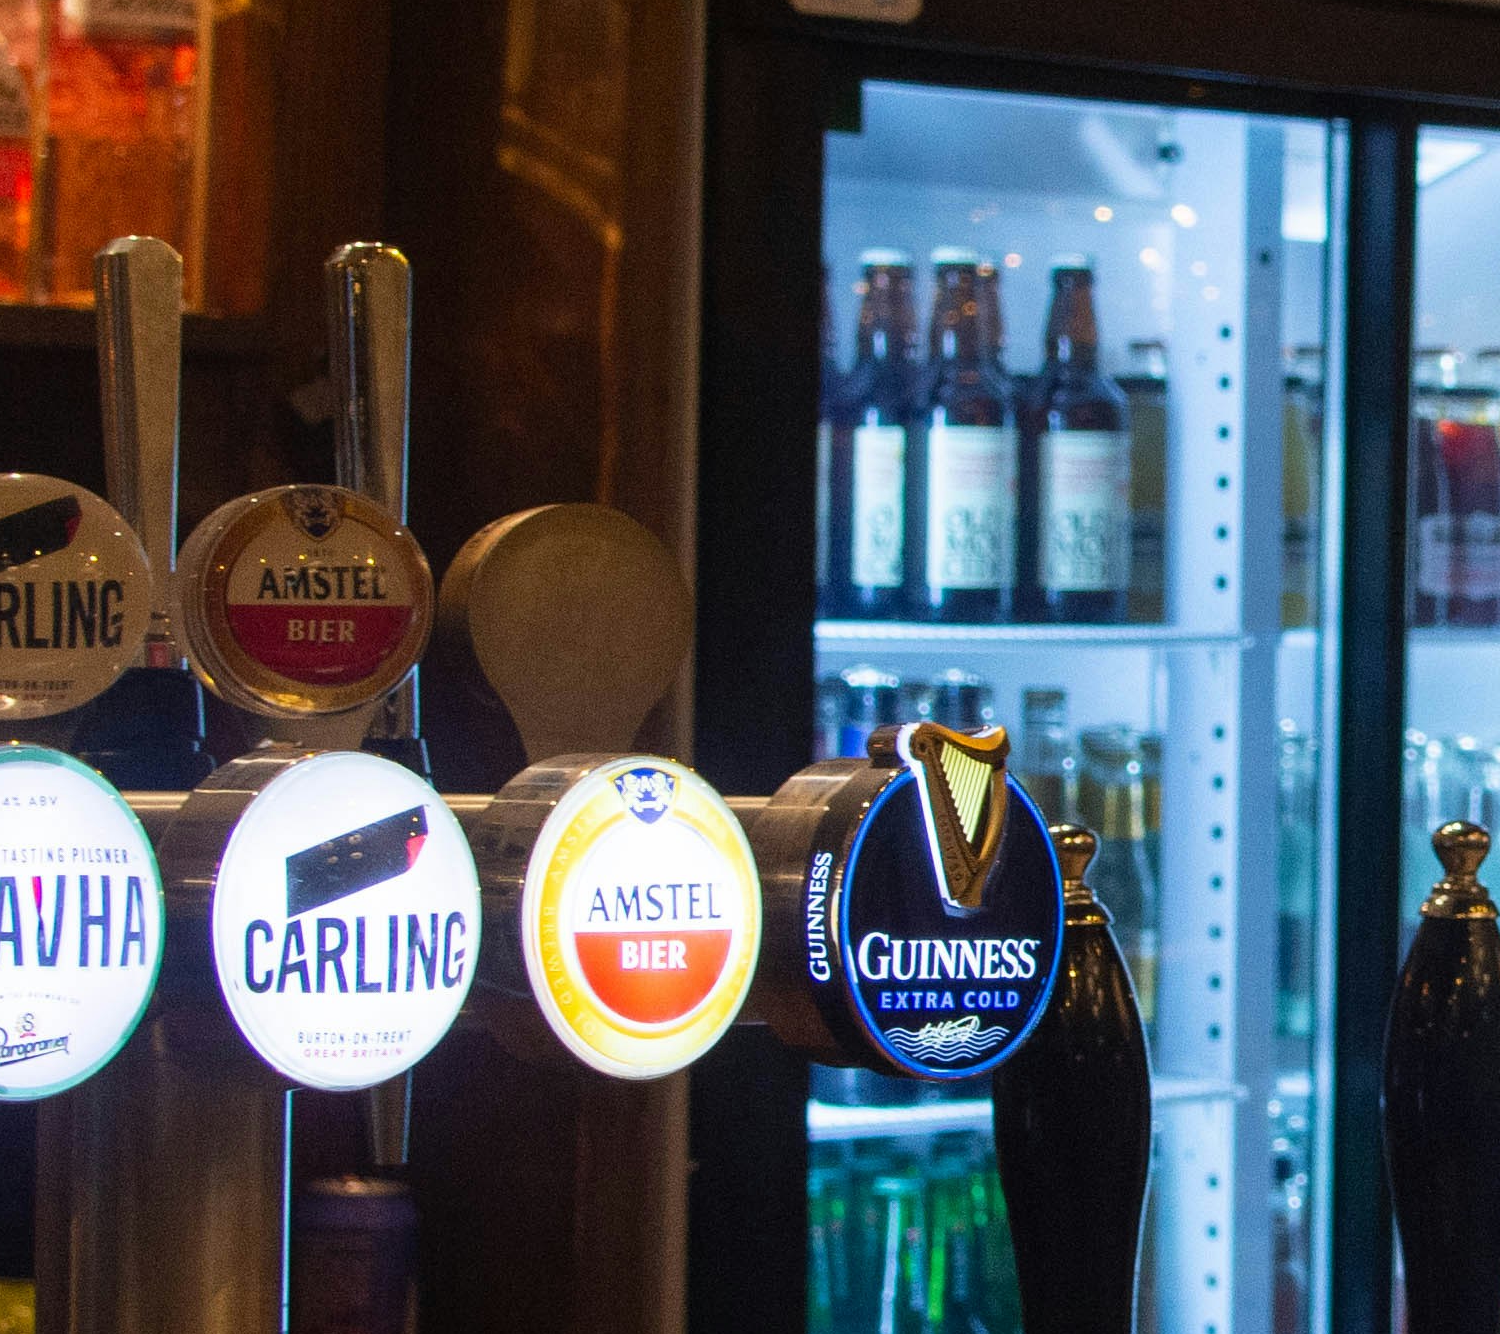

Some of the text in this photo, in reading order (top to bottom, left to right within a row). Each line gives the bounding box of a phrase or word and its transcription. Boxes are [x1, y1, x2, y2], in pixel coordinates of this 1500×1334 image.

[257, 565, 387, 600] AMSTEL
[287, 618, 356, 643] BIER
[28, 795, 58, 807] ABV
[2, 848, 65, 865] TASTING
[71, 847, 130, 864] PILSNER
[587, 882, 722, 923] AMSTEL
[807, 850, 833, 982] GUINNESS
[244, 910, 467, 994] CARLING
[619, 939, 688, 971] BIER
[857, 930, 1038, 981] GUINNESS
[880, 990, 1021, 1009] EXTRA COLD
[297, 1029, 413, 1045] BURTON-ON-TRENT
[303, 1047, 403, 1059] GREAT BRITAIN
